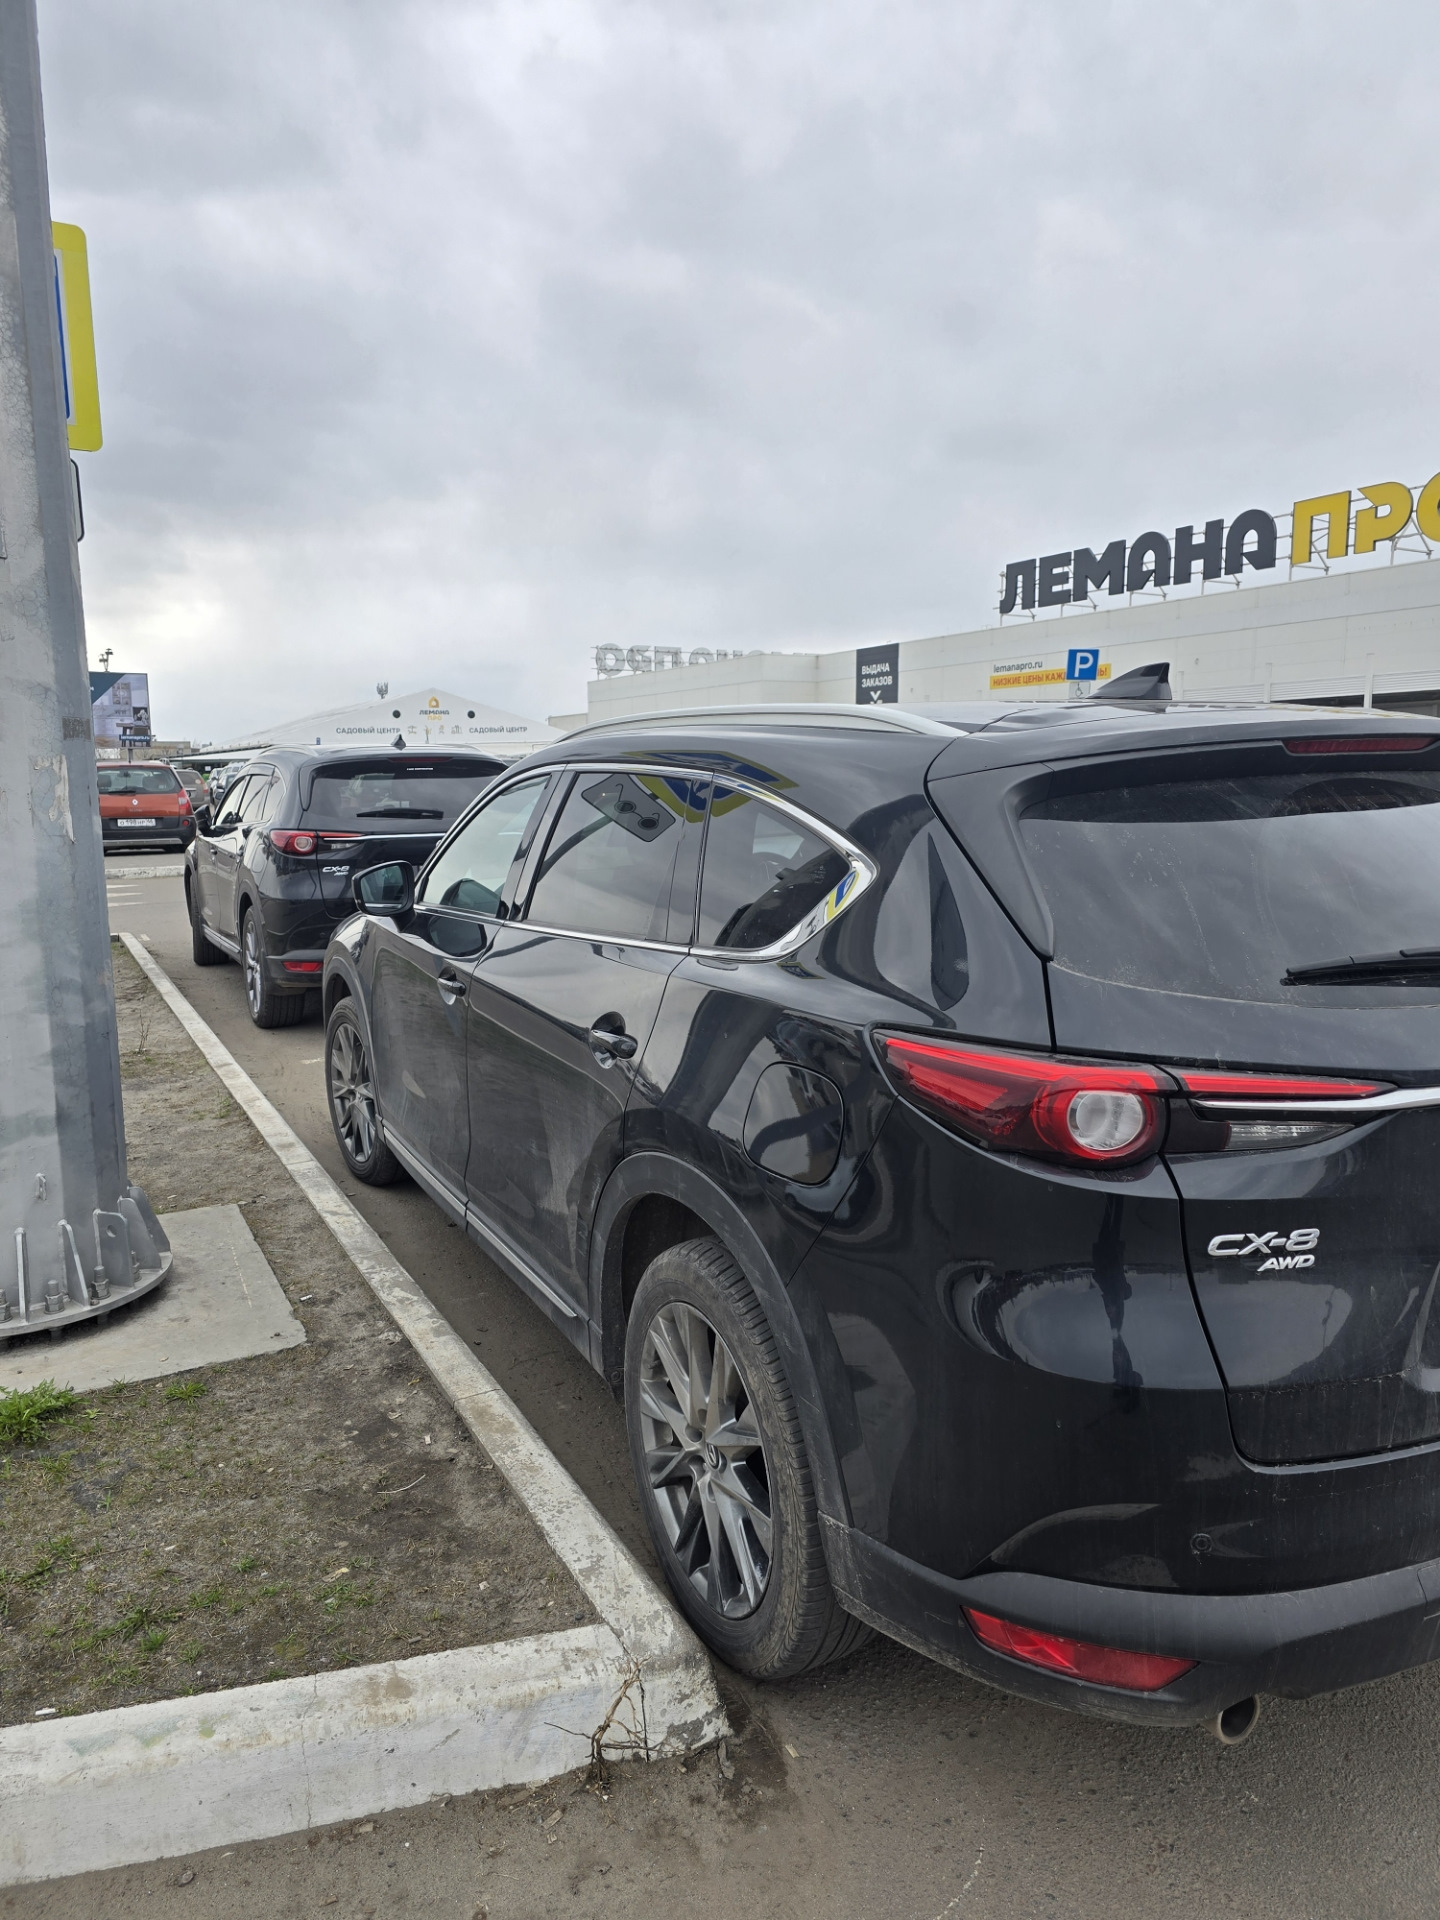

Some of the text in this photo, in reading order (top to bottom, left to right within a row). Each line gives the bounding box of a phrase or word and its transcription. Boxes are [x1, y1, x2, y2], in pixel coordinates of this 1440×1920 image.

[999, 508, 1277, 615] ЛЕМАНА
[861, 662, 890, 675] ВЫДАЧА
[993, 661, 1043, 674] lemanapro.ru
[861, 675, 893, 688] ЗАКАЗОВ
[993, 675, 1022, 687] НИЗКИЕ
[1022, 674, 1044, 685] ЦЕНЫ
[336, 726, 400, 735] САДОВЫЙ ЦЕНТР
[469, 726, 504, 735] САДОВЫЙ
[1207, 1228, 1320, 1256] CX-8
[1257, 1254, 1316, 1272] AWD
